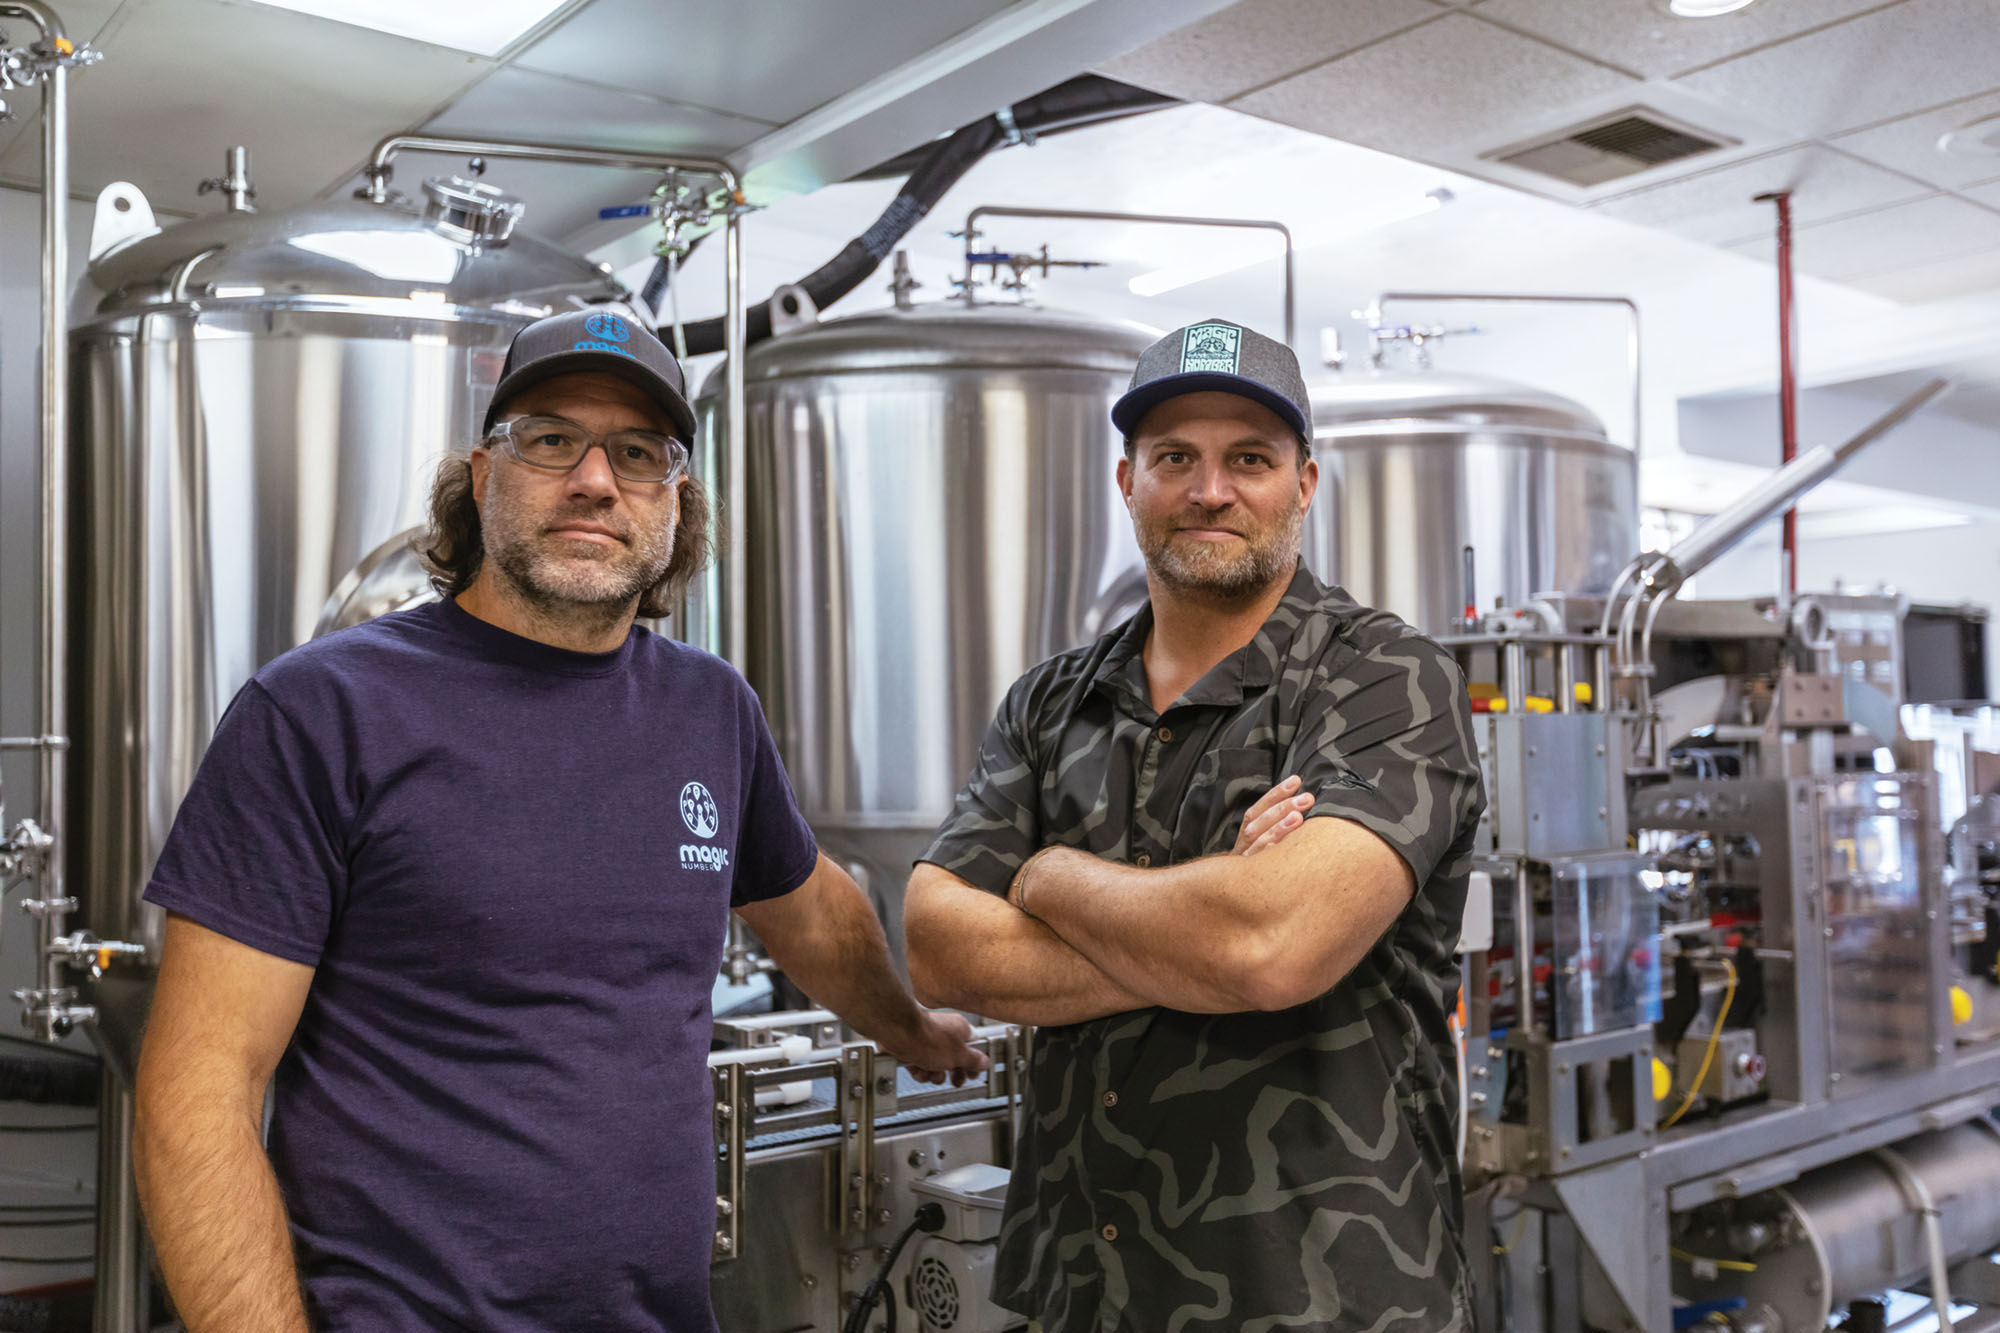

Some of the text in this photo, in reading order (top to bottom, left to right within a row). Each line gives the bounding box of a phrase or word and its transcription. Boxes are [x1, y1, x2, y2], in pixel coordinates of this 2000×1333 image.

[1184, 359, 1234, 374] NUMBER
[680, 845, 729, 872] magic
[681, 862, 715, 871] NUMBER
